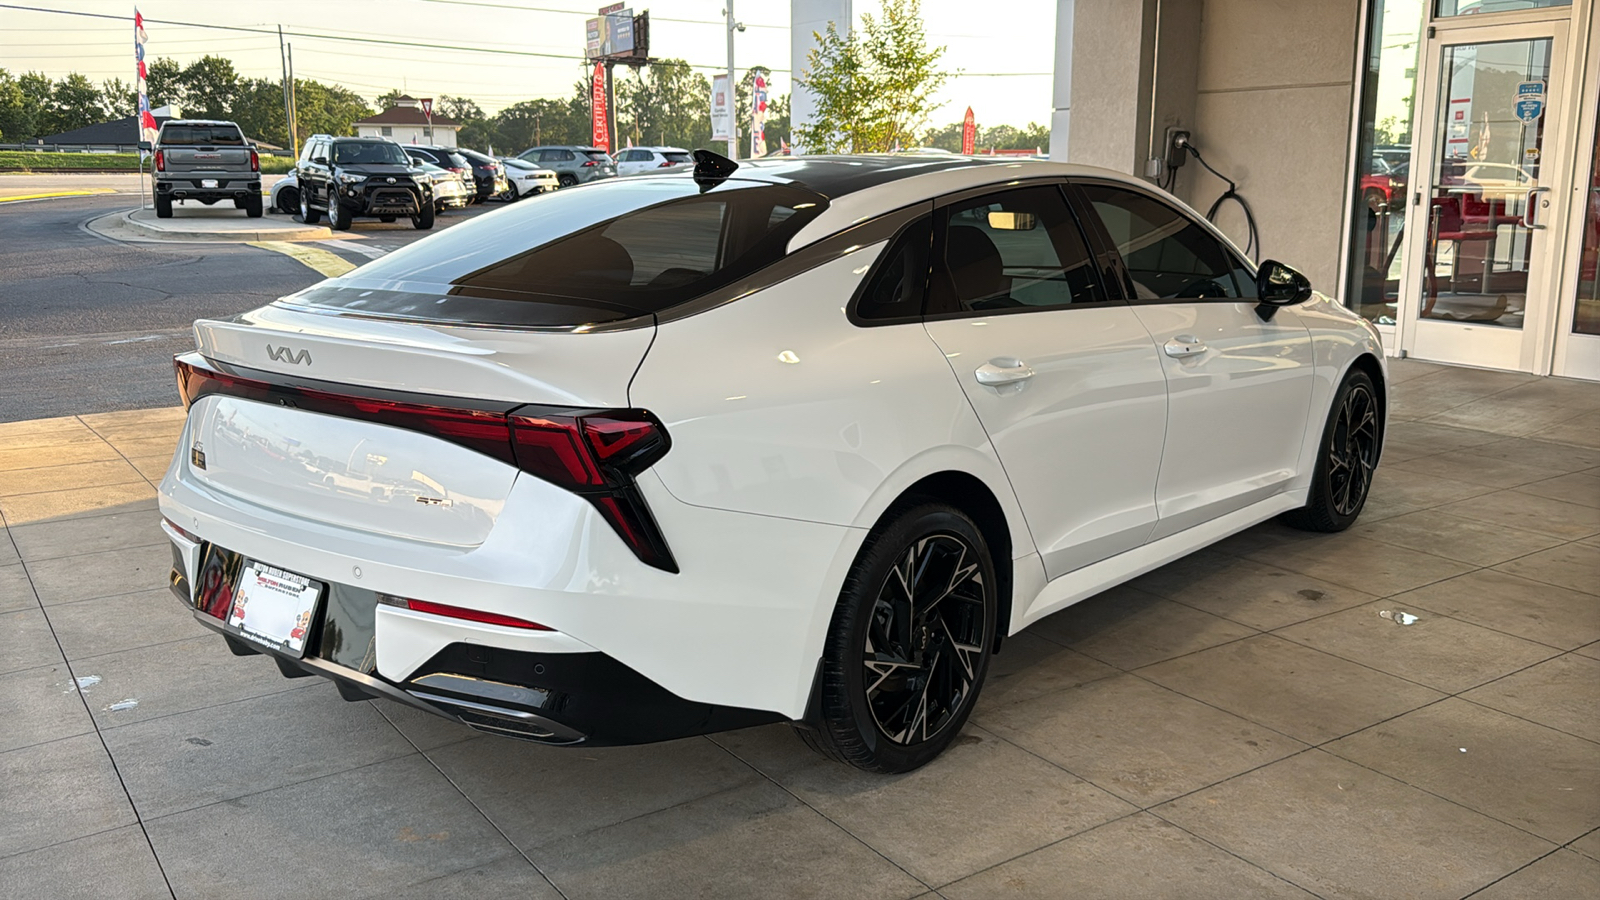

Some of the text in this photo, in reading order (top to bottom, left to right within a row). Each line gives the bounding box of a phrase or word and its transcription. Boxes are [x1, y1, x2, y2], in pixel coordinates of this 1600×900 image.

[594, 86, 604, 142] CERTIFIED
[266, 343, 312, 366] KIA
[257, 576, 302, 593] MILTON RUBEN
